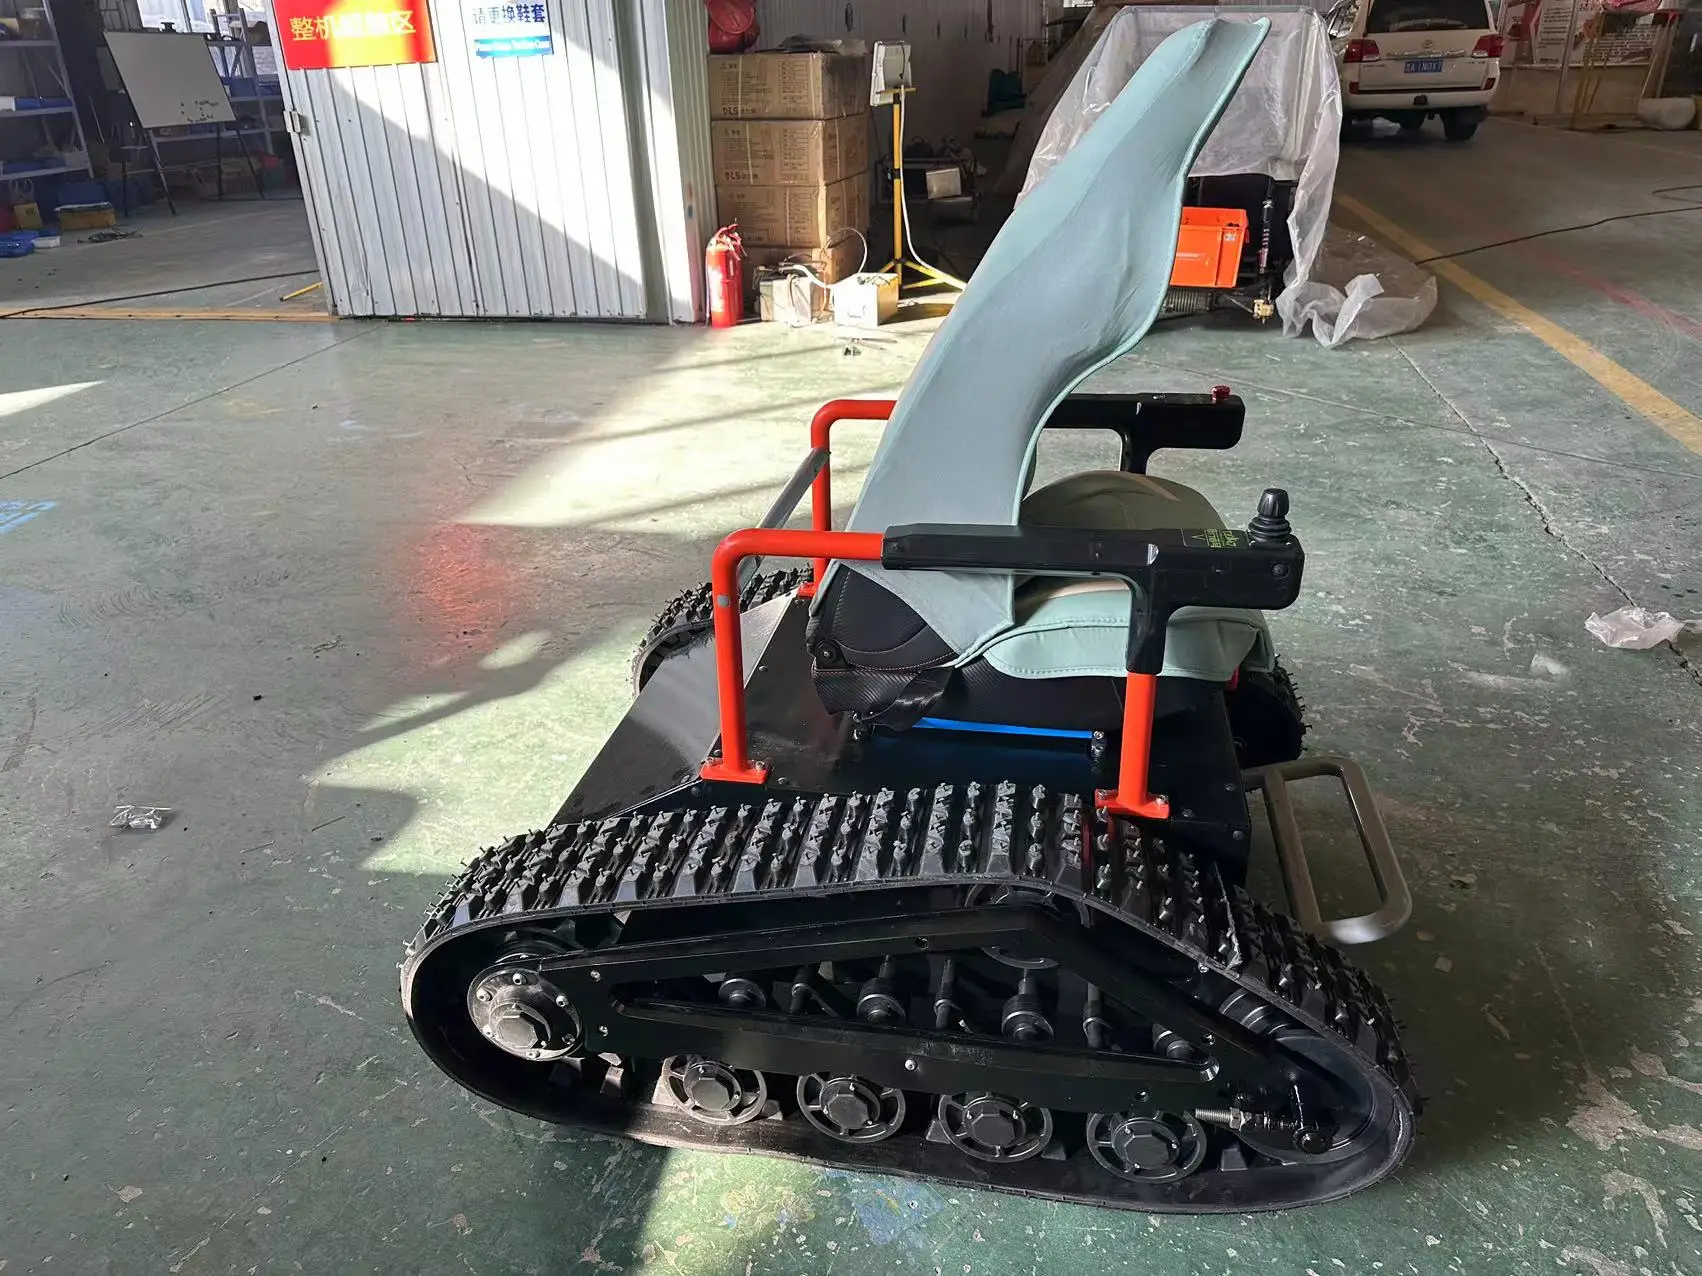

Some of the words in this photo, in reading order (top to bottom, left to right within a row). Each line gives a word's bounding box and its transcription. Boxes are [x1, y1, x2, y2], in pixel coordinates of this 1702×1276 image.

[289, 10, 416, 40] 整机区
[472, 4, 545, 24] 请更换鞋套
